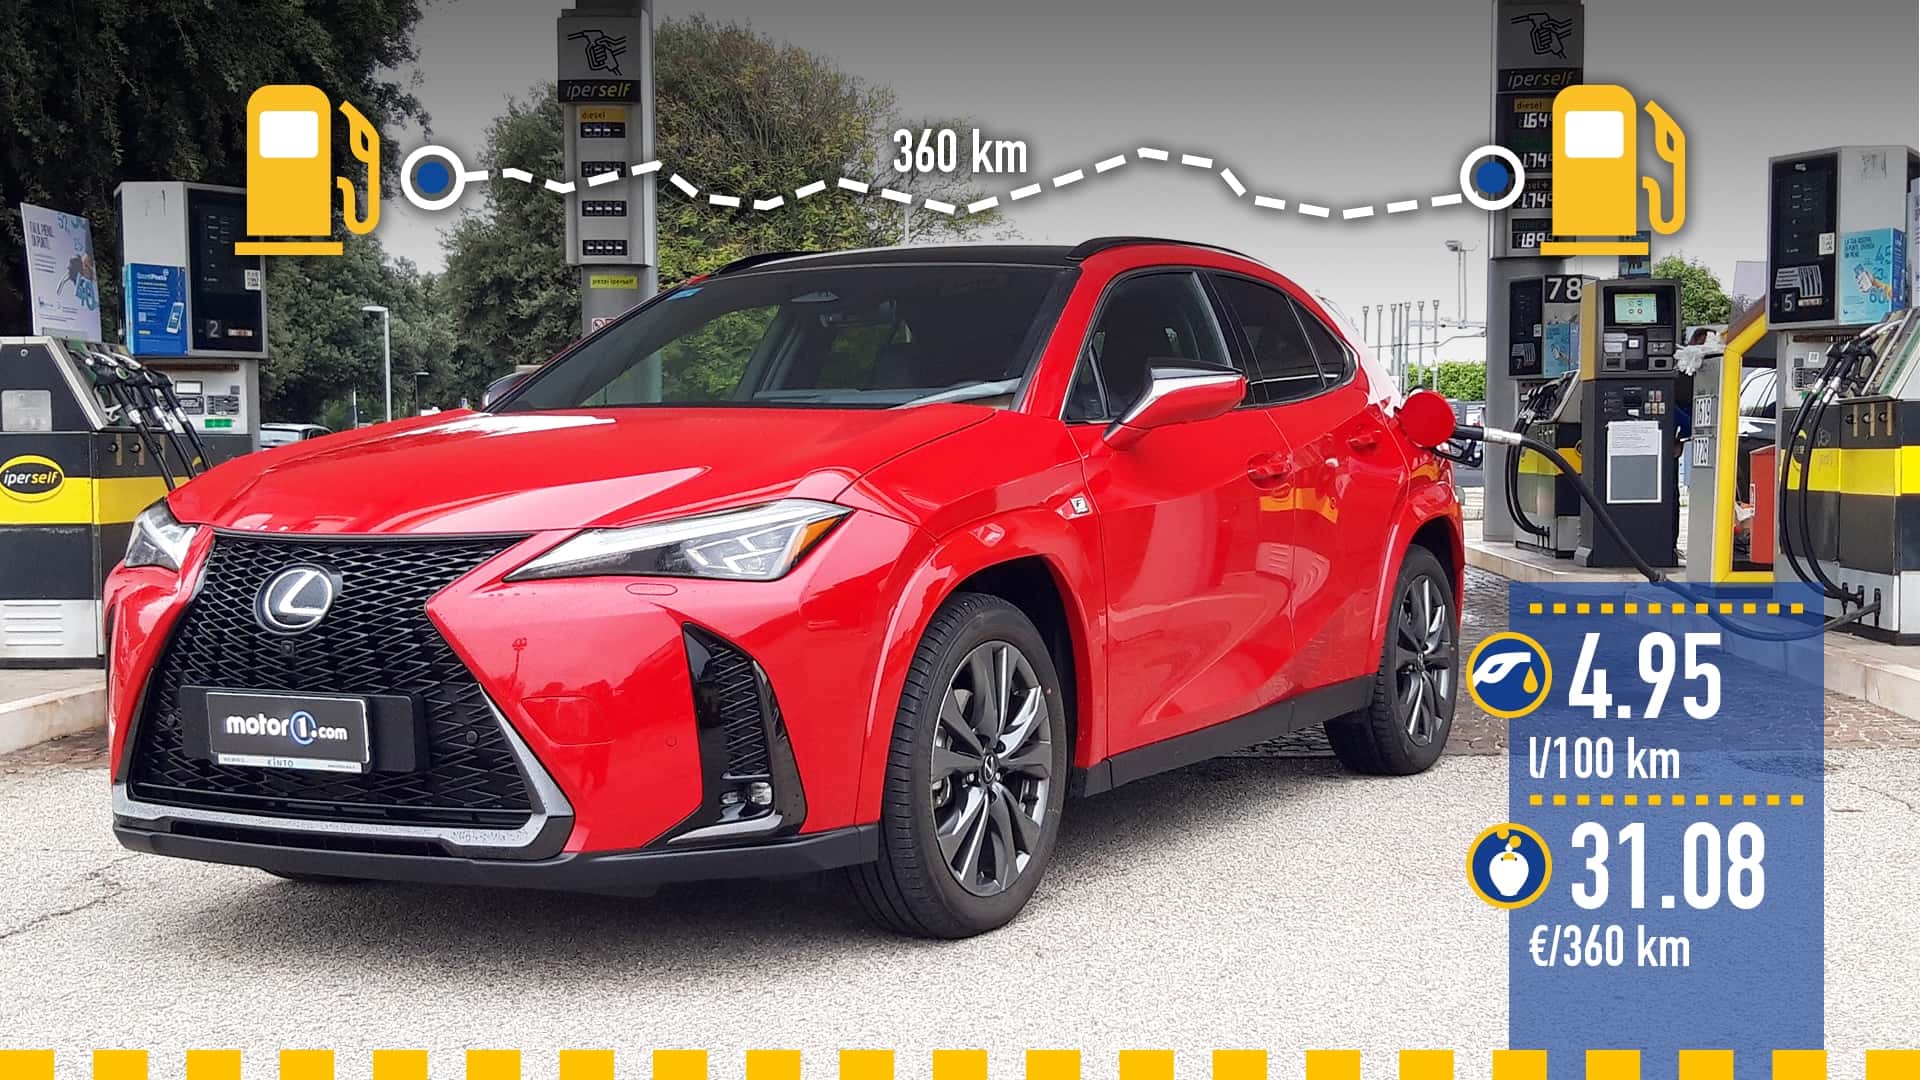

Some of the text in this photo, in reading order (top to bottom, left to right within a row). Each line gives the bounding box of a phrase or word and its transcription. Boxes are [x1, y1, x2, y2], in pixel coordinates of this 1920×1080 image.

[1508, 71, 1573, 90] iperself
[567, 81, 632, 100] iperself
[1547, 278, 1582, 300] 78
[1784, 294, 1793, 311] 5
[209, 320, 219, 337] 2
[4, 470, 59, 487] iperself
[226, 711, 348, 744] motor1.com
